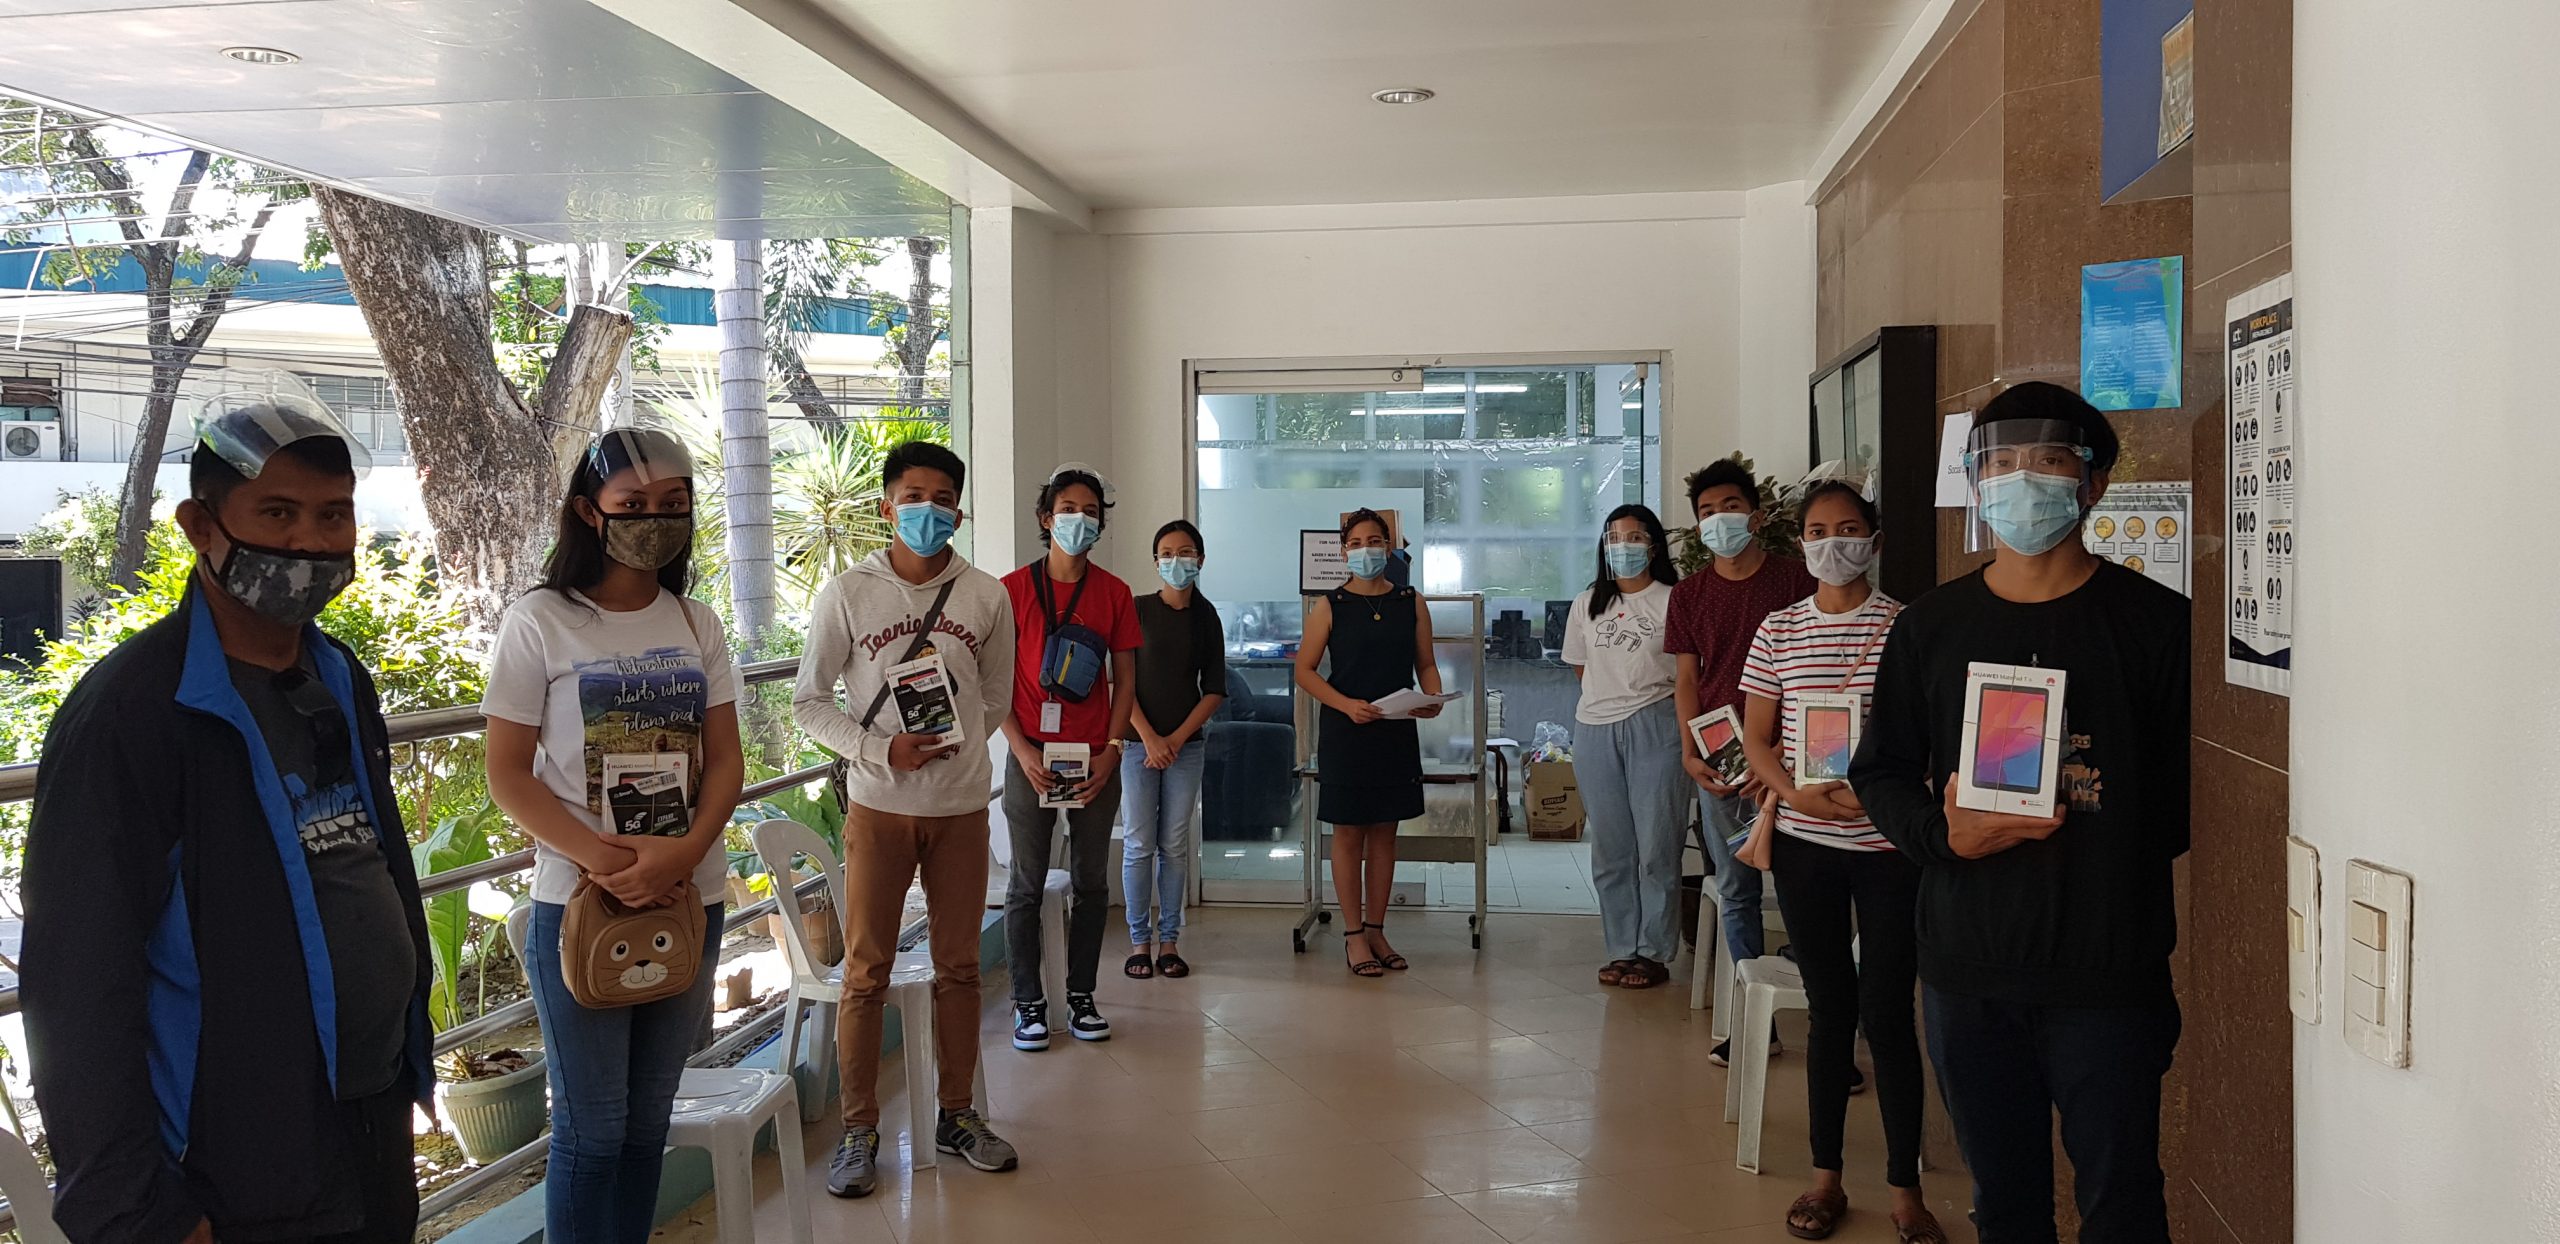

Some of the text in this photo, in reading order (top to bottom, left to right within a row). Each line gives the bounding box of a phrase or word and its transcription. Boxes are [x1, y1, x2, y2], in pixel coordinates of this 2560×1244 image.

[614, 654, 688, 675] Adventure
[614, 674, 701, 706] starts where
[624, 701, 697, 736] plans end
[624, 820, 642, 832] 5G
